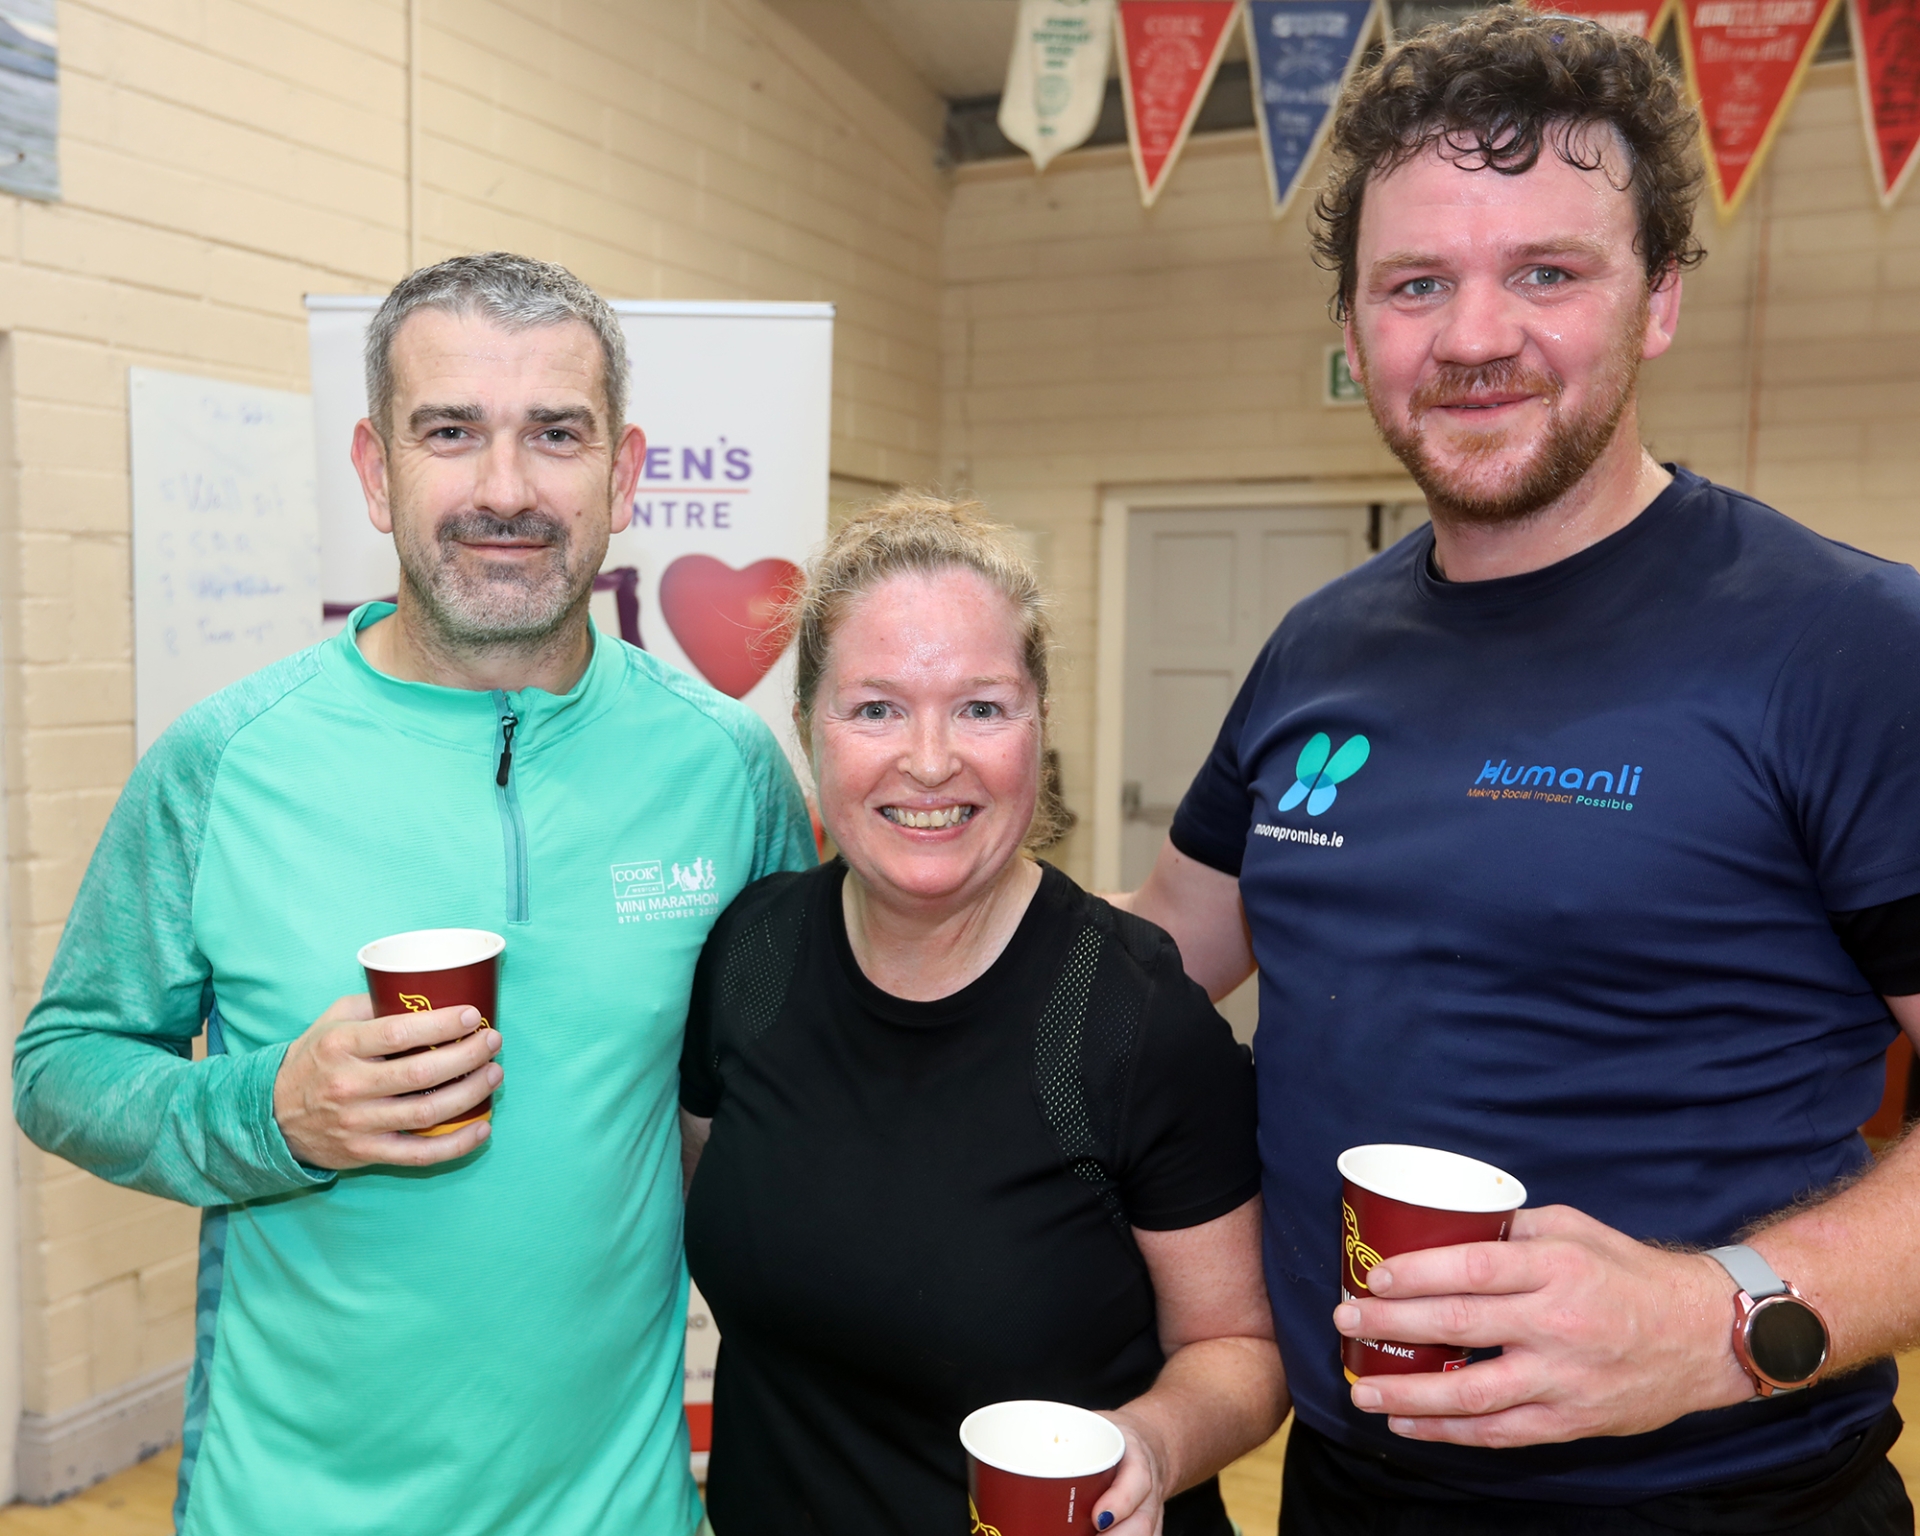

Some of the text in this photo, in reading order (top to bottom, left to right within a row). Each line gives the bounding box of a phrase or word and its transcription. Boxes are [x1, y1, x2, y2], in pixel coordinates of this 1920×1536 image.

[646, 436, 751, 480] EN'S
[632, 502, 730, 528] NTRE
[1474, 758, 1643, 797] Humanli
[1466, 788, 1634, 811] Making Social Impact Possible
[1254, 823, 1344, 848] moorepromise.ie
[631, 886, 659, 894] MEDICAL
[616, 893, 719, 914] MINI MARATHON
[618, 915, 640, 925] 8TH
[645, 909, 695, 921] OCTOBER
[1382, 1343, 1415, 1359] AWAKE
